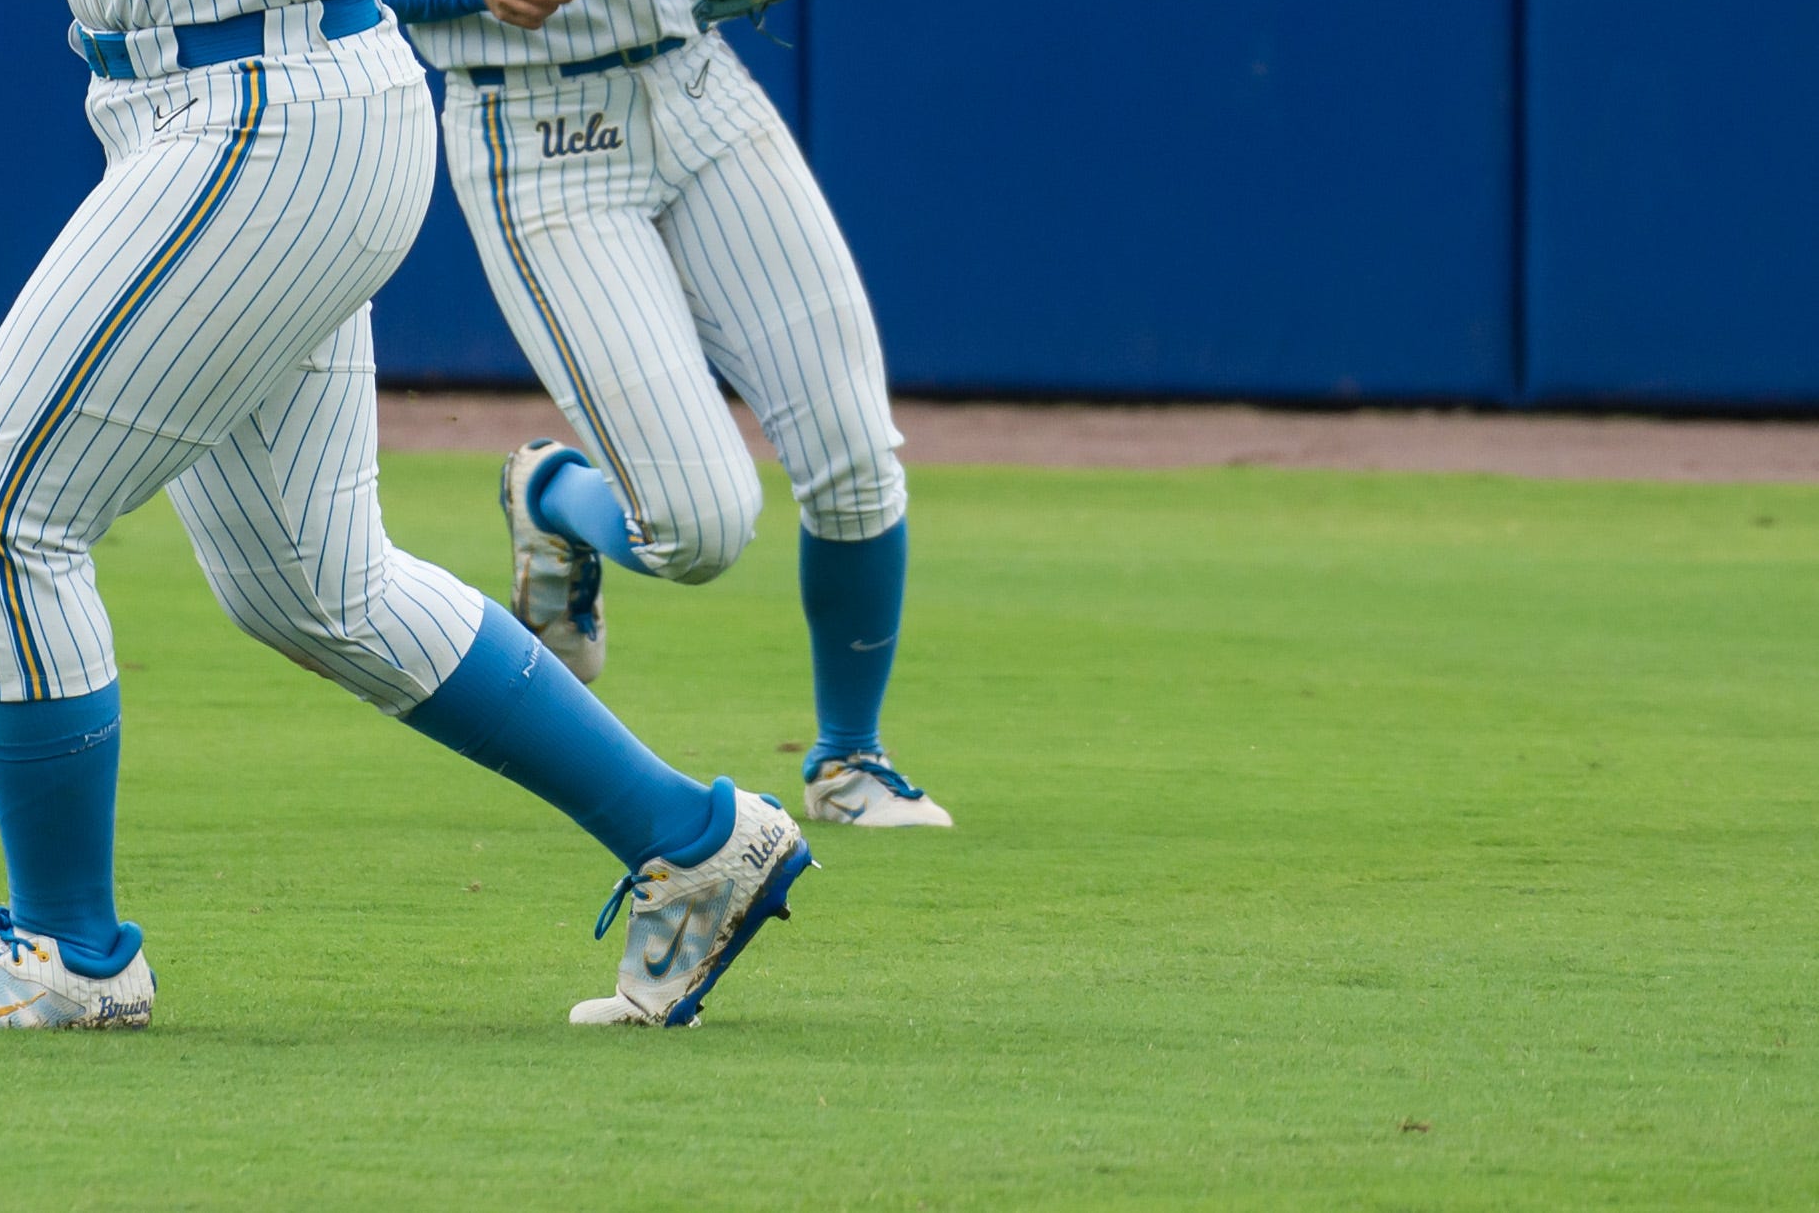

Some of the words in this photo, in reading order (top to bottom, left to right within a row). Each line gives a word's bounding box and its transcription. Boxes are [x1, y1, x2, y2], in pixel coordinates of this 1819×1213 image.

[535, 112, 624, 159] Ucla
[84, 714, 121, 743] NIK
[742, 823, 785, 870] Ucla
[95, 994, 152, 1020] Bruin
